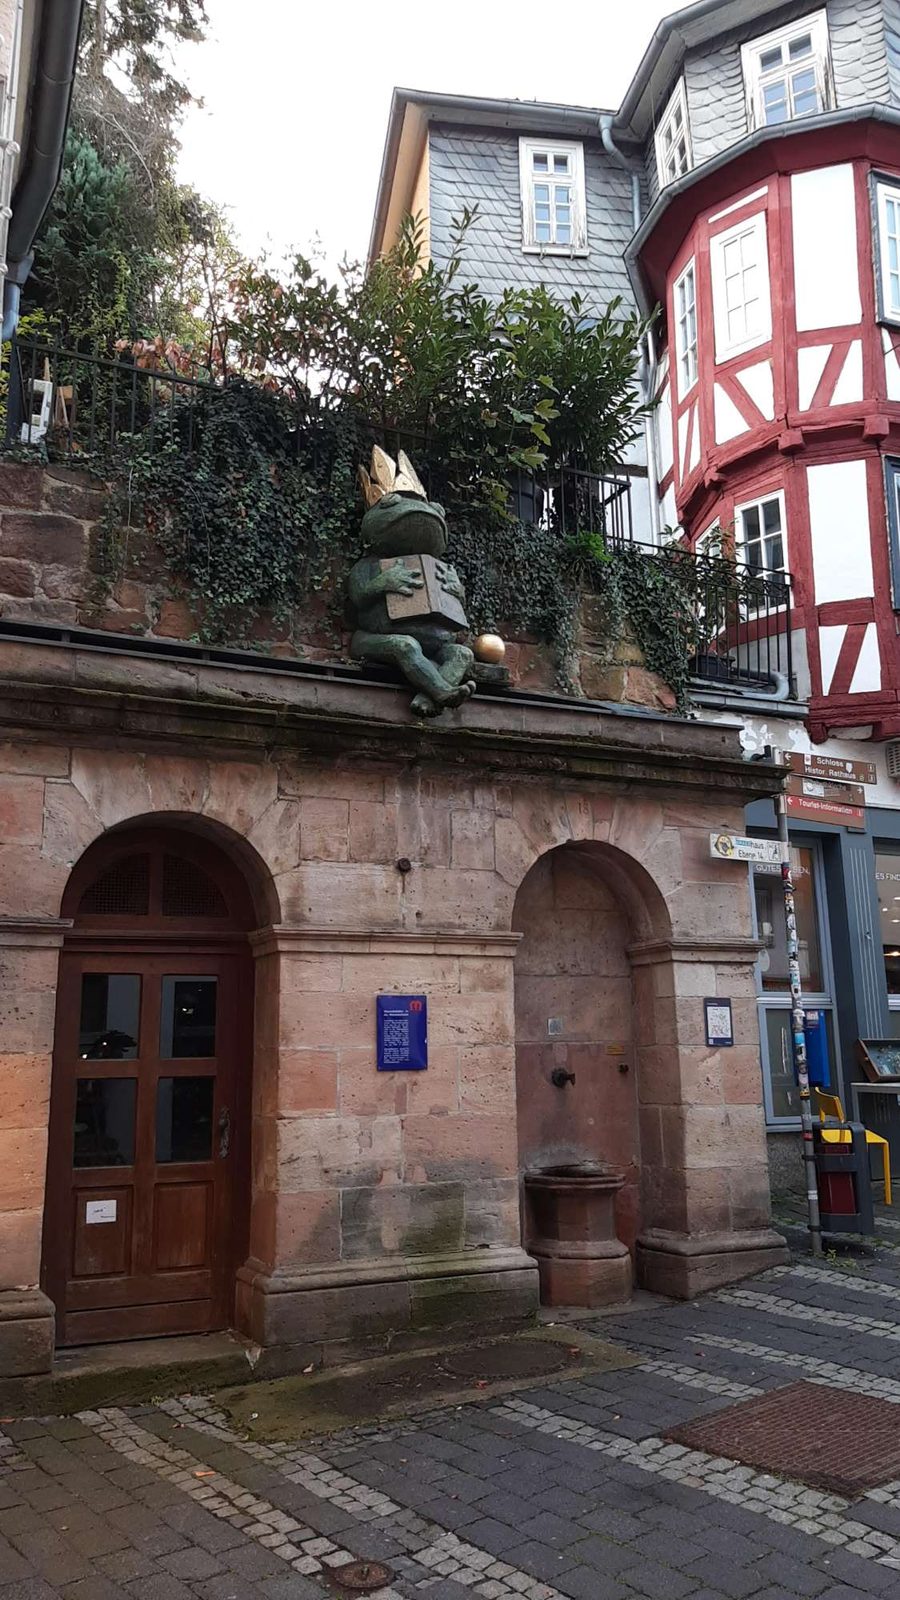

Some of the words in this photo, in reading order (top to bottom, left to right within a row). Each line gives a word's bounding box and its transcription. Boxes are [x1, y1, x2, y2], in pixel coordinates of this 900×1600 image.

[816, 757, 844, 768] Schloss
[829, 769, 857, 780] Rathaus
[799, 799, 853, 814] Tourist-Information
